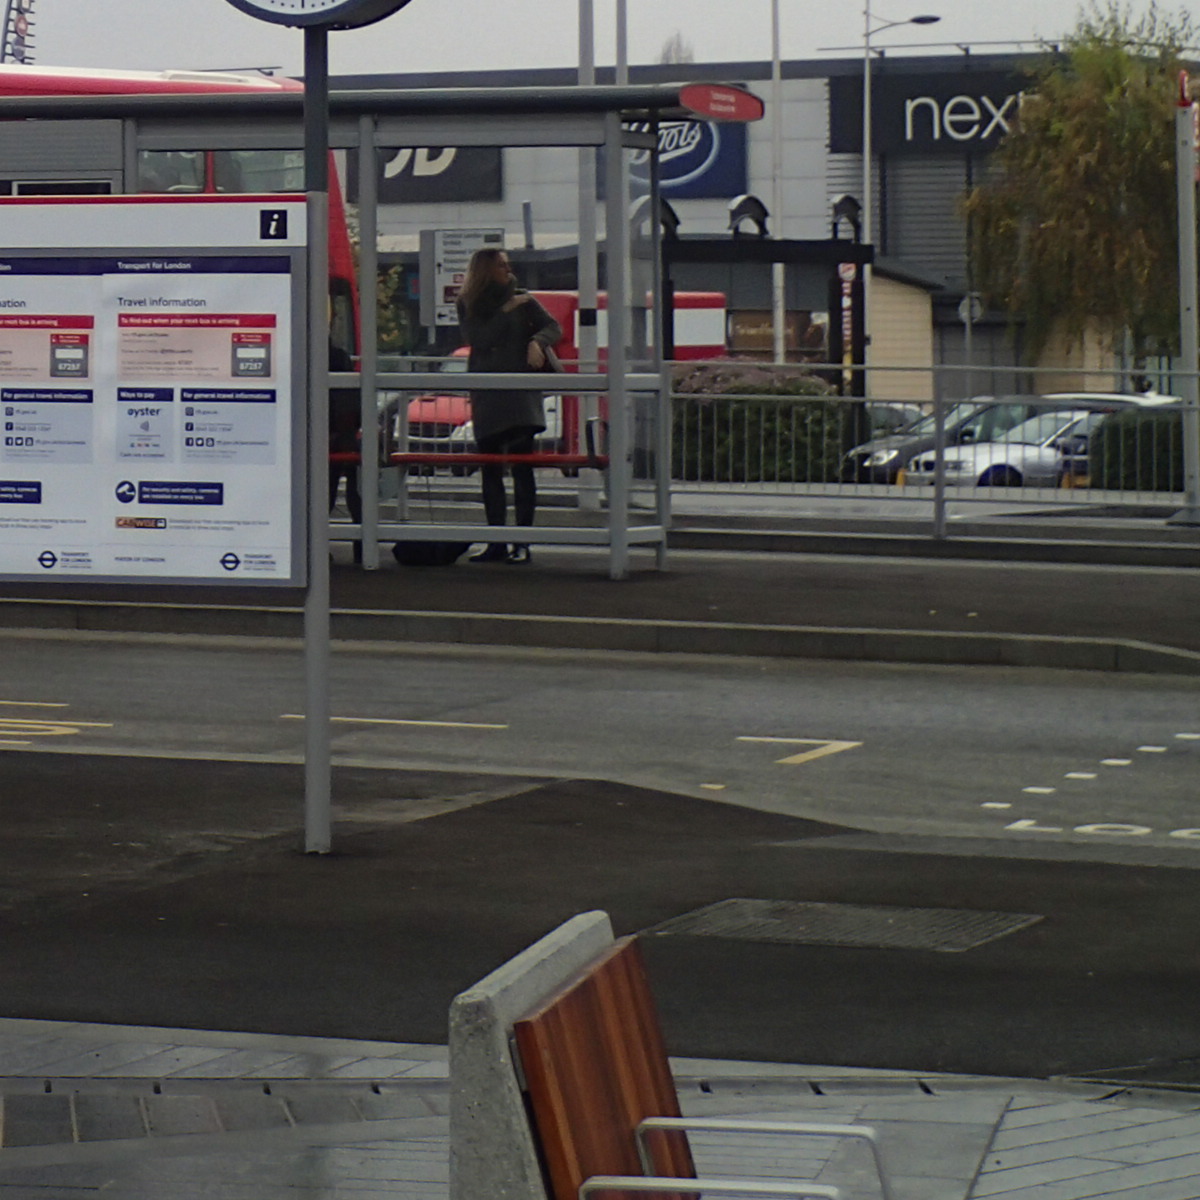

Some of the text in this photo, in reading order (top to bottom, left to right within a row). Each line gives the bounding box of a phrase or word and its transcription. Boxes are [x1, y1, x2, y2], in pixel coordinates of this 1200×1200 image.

[117, 261, 191, 271] Transport for London
[118, 297, 206, 307] Travel information
[127, 407, 161, 418] oyster
